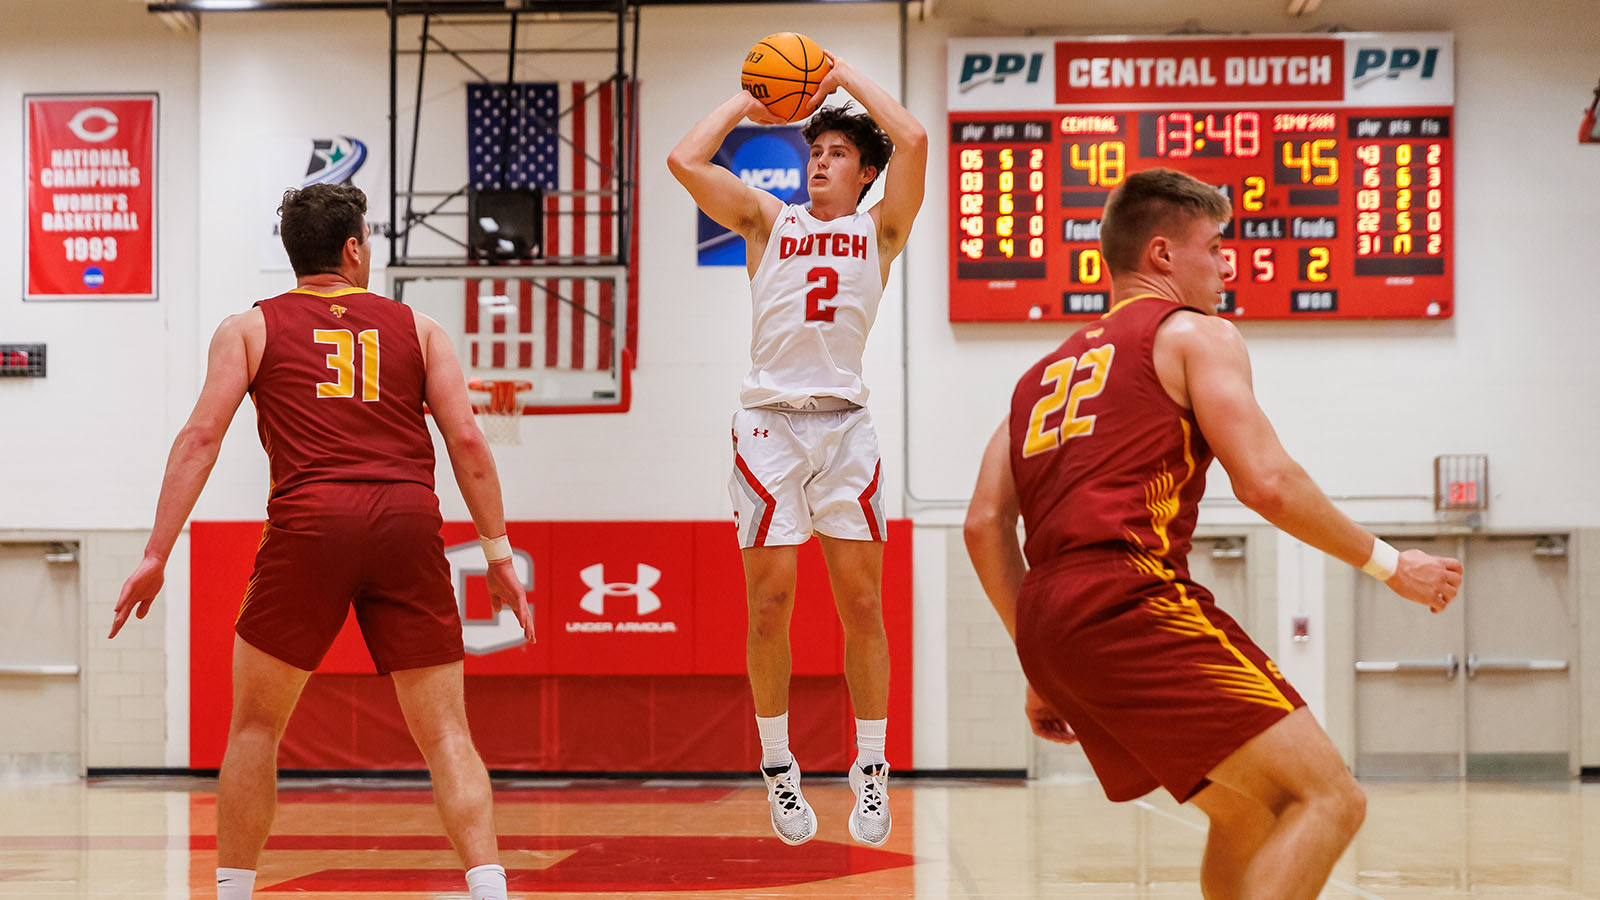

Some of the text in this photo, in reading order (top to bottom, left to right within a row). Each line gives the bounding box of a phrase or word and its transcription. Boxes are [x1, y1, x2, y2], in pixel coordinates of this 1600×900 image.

[958, 53, 1044, 85] PPI
[1069, 56, 1332, 88] CENTRAL DUTCH
[1352, 48, 1440, 81] PPI
[1060, 115, 1120, 135] CENTRAL
[1155, 112, 1261, 159] 13:48
[51, 148, 131, 168] NATIONAL
[1029, 148, 1044, 171] 2
[1069, 141, 1126, 188] 48
[1282, 139, 1340, 186] 45
[1395, 143, 1412, 166] 0
[1426, 143, 1442, 166] 2
[40, 167, 141, 188] CHAMPIONS
[740, 167, 801, 191] NCAA
[999, 171, 1015, 193] 0
[1029, 171, 1044, 193] 0
[1395, 166, 1412, 189] 6
[1426, 166, 1442, 189] 3
[52, 193, 129, 212] WOMEN'S
[1034, 193, 1044, 215] 1
[1242, 176, 1266, 212] 2
[1355, 188, 1442, 211] 03 2 0
[41, 211, 140, 232] BASKETBALL
[1029, 215, 1044, 237] 0
[1356, 211, 1442, 234] 22 5 0
[63, 236, 118, 262] 1993
[779, 232, 868, 261] DUTCH
[999, 238, 1015, 259] 4
[1029, 237, 1044, 260] 0
[1356, 233, 1382, 256] 31
[1426, 233, 1442, 256] 2
[1078, 249, 1102, 284] 0
[1252, 246, 1276, 284] 5
[1306, 246, 1331, 284] 2
[804, 266, 839, 323] 2
[313, 328, 380, 402] 31
[1022, 342, 1115, 459] 22
[565, 621, 614, 634] UNDER
